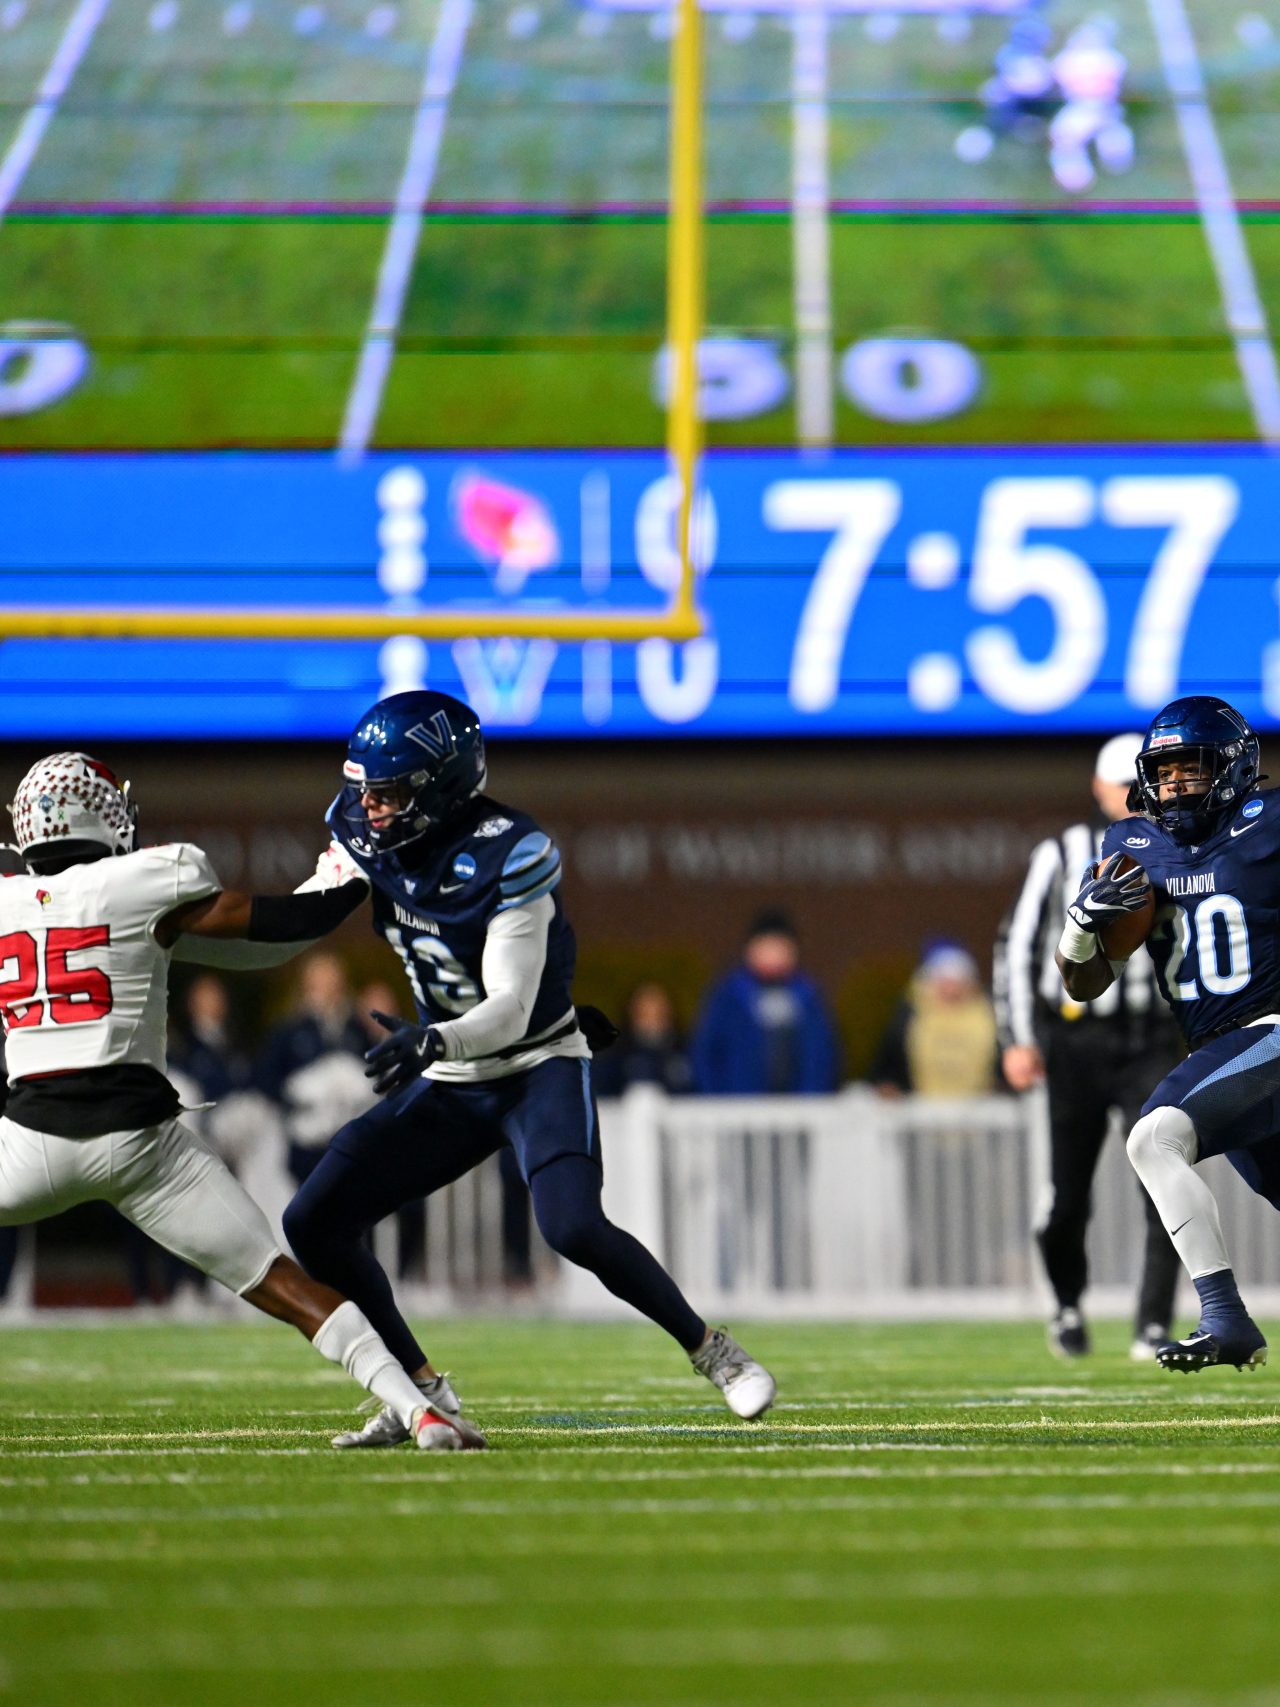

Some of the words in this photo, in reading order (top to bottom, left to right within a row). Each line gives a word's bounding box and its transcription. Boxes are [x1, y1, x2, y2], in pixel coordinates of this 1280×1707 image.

[762, 476, 1242, 714] 7:57
[1152, 736, 1178, 746] Riddell
[1244, 805, 1262, 815] NCAA
[1126, 837, 1147, 846] CAA
[1166, 872, 1215, 897] VILLANOVA
[393, 901, 441, 936] VILLANOVA
[1153, 894, 1252, 1002] 20
[0, 924, 114, 1036] 25
